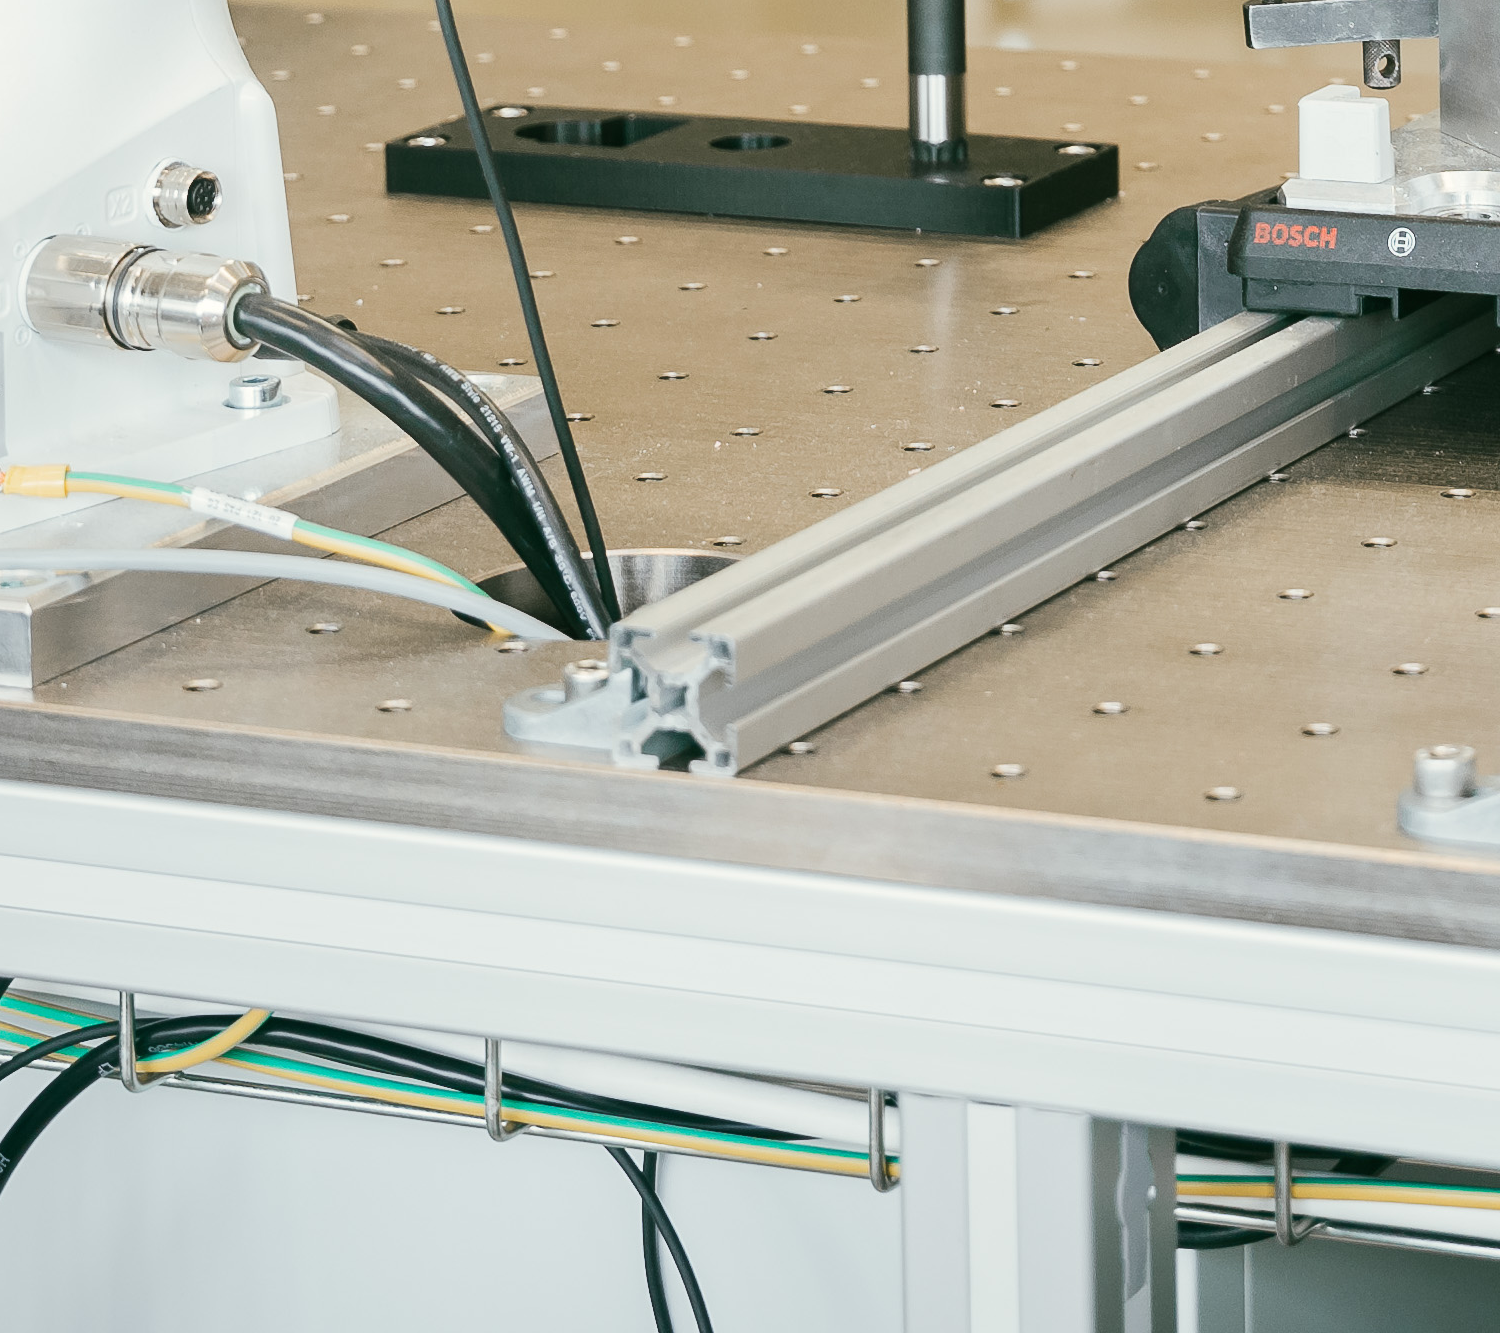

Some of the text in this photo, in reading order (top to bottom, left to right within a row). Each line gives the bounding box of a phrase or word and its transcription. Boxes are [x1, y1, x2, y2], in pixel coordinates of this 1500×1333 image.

[1254, 222, 1337, 249] BOSCH
[481, 405, 502, 433] 21215
[501, 436, 520, 464] VW-1
[516, 468, 536, 496] AWM
[543, 526, 557, 548] A/B
